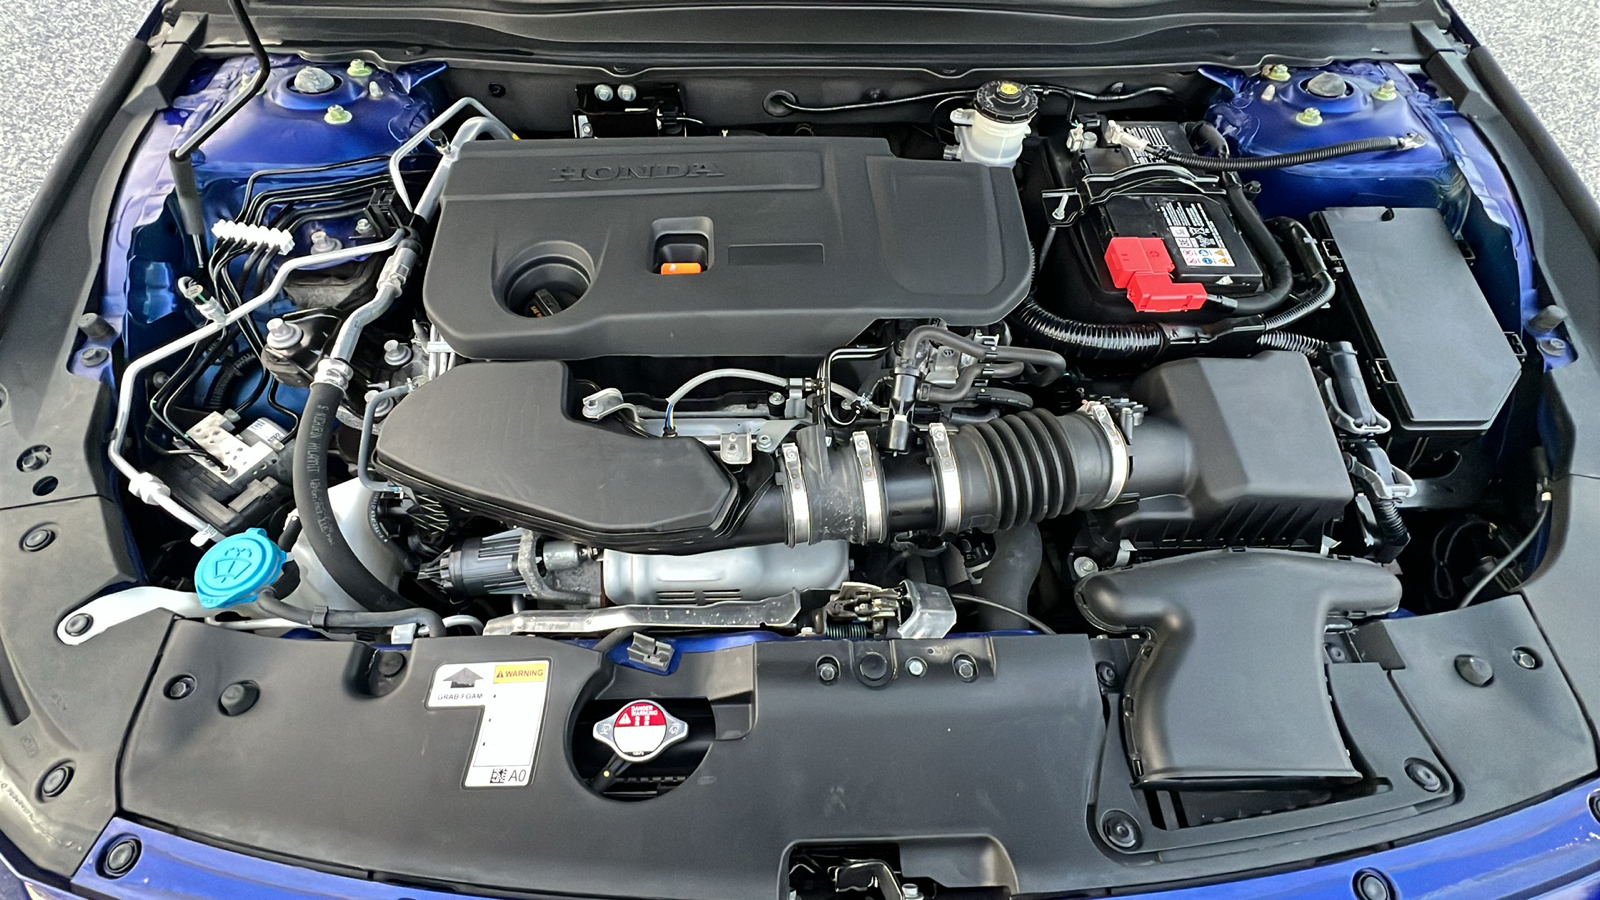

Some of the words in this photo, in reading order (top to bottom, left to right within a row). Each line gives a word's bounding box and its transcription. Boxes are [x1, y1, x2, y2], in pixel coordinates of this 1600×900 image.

[549, 162, 724, 182] HONDA
[505, 669, 544, 678] WARNING
[437, 693, 460, 701] GRAB
